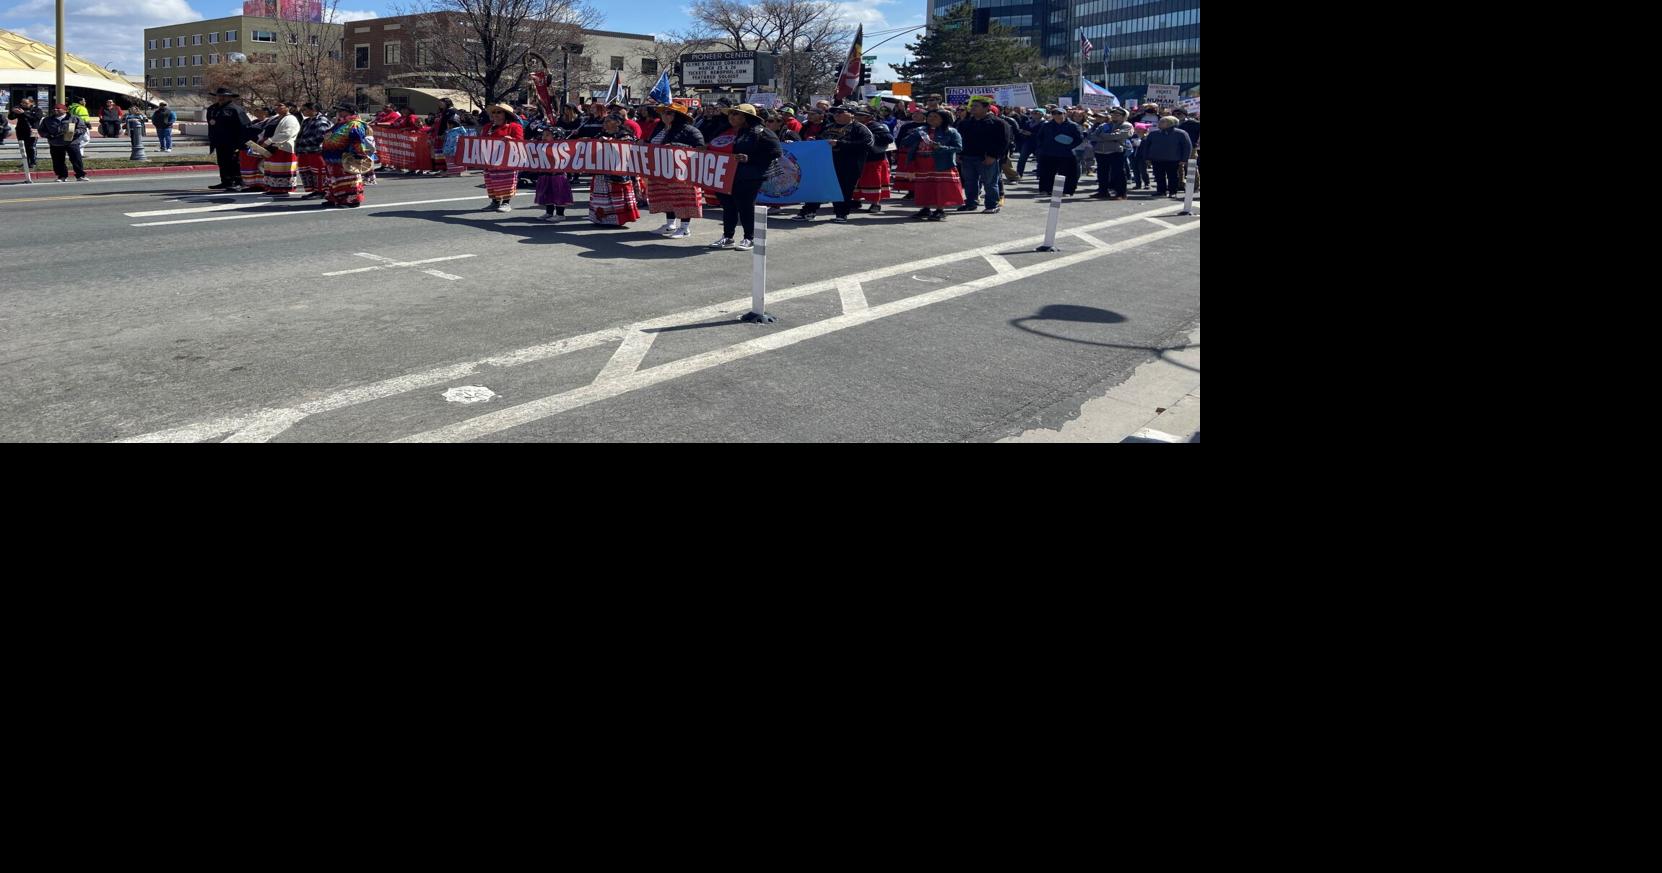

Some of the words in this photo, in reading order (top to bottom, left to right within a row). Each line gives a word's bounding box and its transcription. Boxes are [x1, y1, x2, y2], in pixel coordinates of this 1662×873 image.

[724, 51, 754, 59] CENTER
[463, 138, 505, 166] LAND
[507, 140, 551, 169] BACK
[552, 141, 571, 170] IS
[572, 141, 650, 175] CLIMATE
[653, 147, 730, 189] JUSTICE
